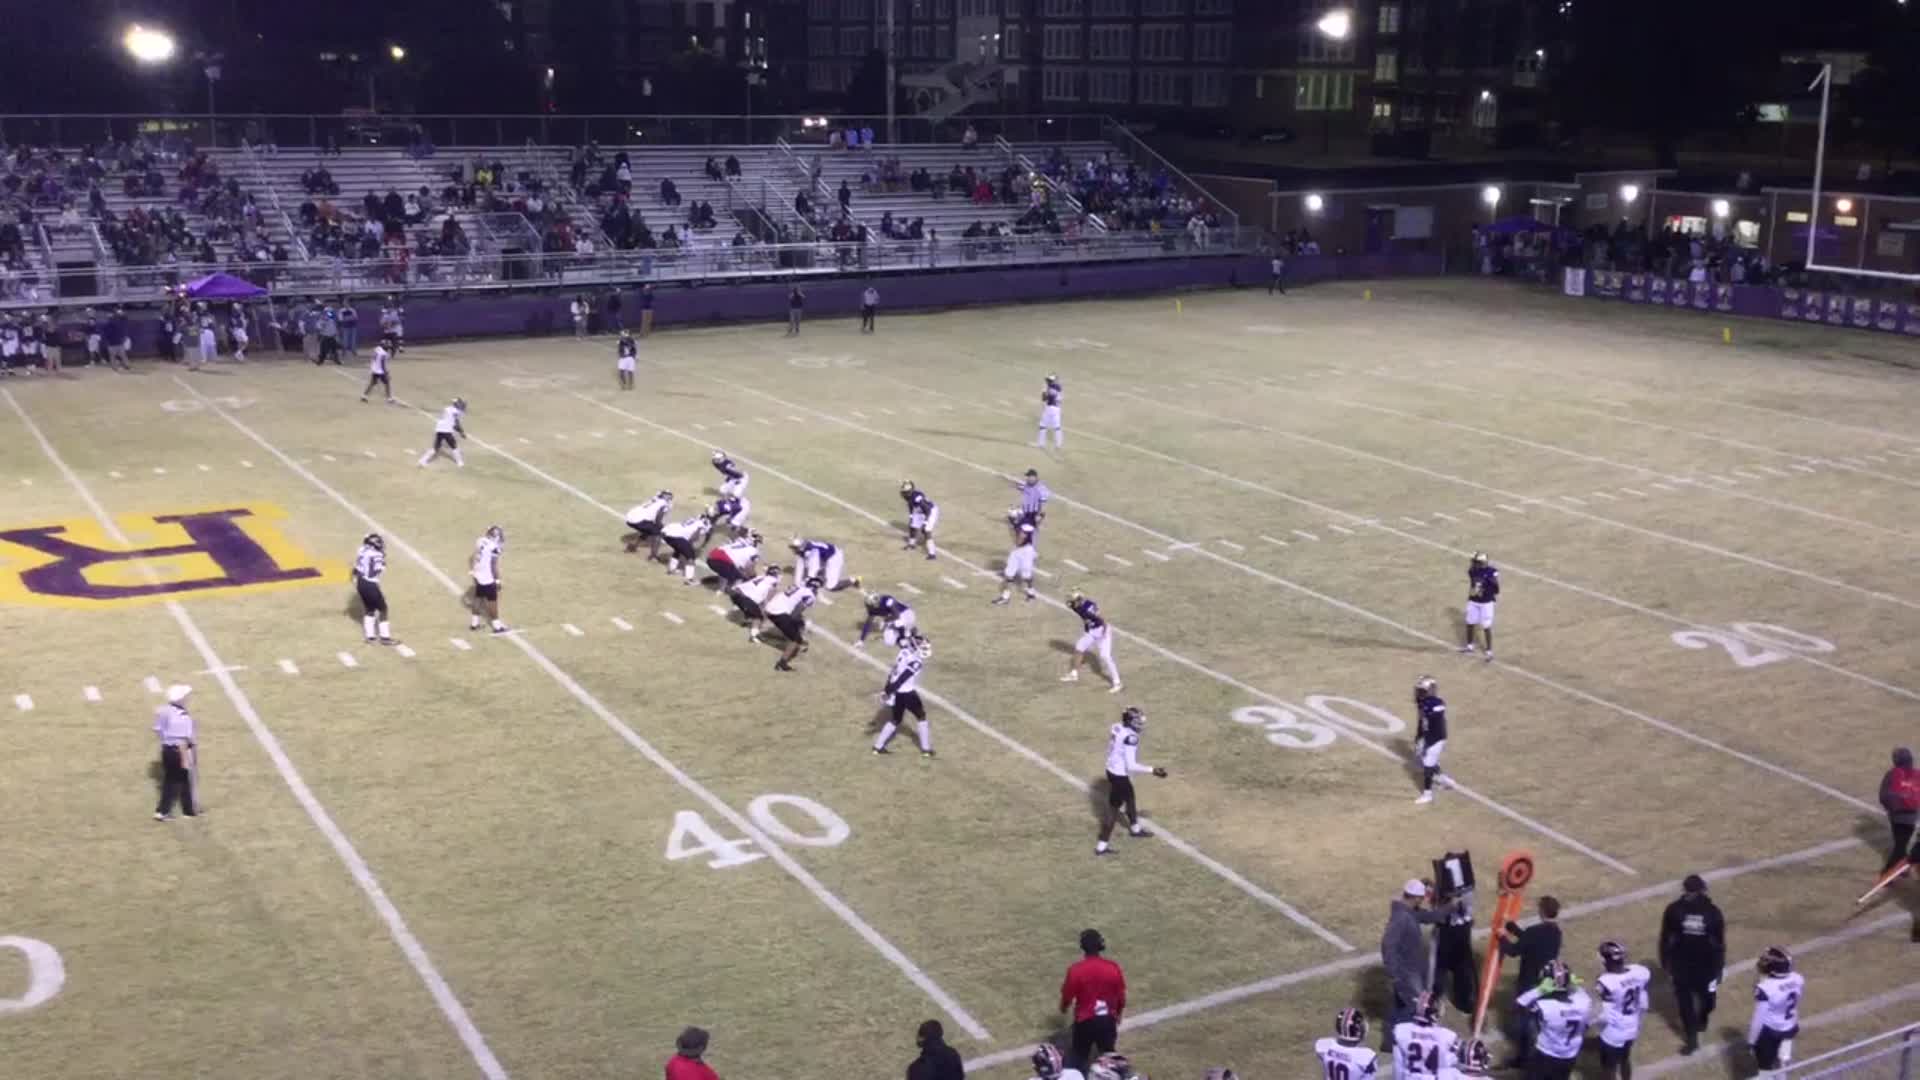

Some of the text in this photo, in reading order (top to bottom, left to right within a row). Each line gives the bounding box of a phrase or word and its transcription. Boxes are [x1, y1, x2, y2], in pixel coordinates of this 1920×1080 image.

[1671, 622, 1837, 667] 20
[1231, 695, 1407, 748] 30
[664, 793, 850, 869] 40
[1445, 858, 1464, 887] 1
[1784, 991, 1798, 1020] 2
[1564, 1019, 1581, 1047] 7
[1407, 1042, 1440, 1076] 24
